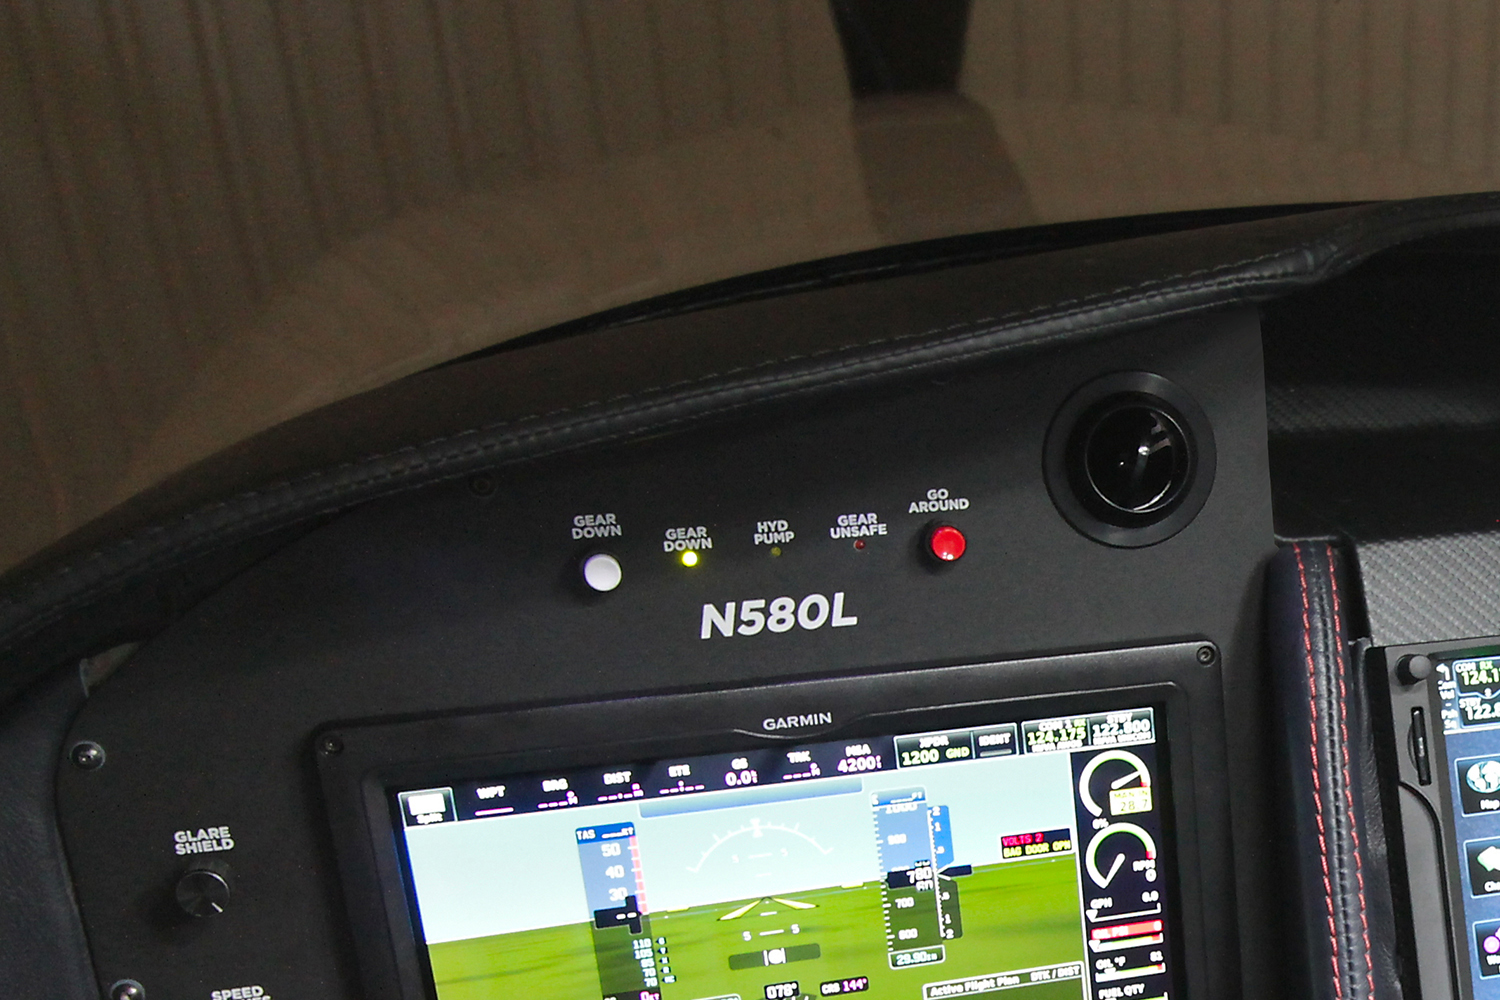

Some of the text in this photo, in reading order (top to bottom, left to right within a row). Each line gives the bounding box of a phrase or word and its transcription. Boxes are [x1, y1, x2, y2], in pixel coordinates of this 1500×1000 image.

[927, 489, 949, 501] GO
[909, 498, 969, 514] AROUND
[573, 513, 616, 527] GEAR
[757, 520, 788, 534] HYD
[837, 513, 877, 527] GEAR
[572, 524, 622, 539] DOWN
[665, 526, 707, 540] GEAR
[754, 531, 794, 545] PUMP
[830, 523, 887, 539] UNSAFE
[663, 537, 713, 553] DOWN
[700, 592, 858, 639] N580L
[763, 712, 832, 731] GARMIN
[1092, 718, 1150, 738] 122.800
[1027, 726, 1087, 746] 124.175
[902, 746, 970, 766] 1200 GND
[603, 771, 631, 784] DIST
[476, 785, 506, 799] WPT
[174, 826, 231, 843] GLARE
[577, 829, 596, 840] TAS
[1002, 835, 1032, 846] VOLTS
[175, 839, 234, 855] SHIELD
[602, 843, 620, 856] 50
[1026, 842, 1049, 854] DOOR
[605, 865, 625, 879] 40
[609, 887, 627, 901] 30
[930, 975, 1020, 997] Active Flight Plan
[1099, 984, 1145, 1000] FUEL QTY
